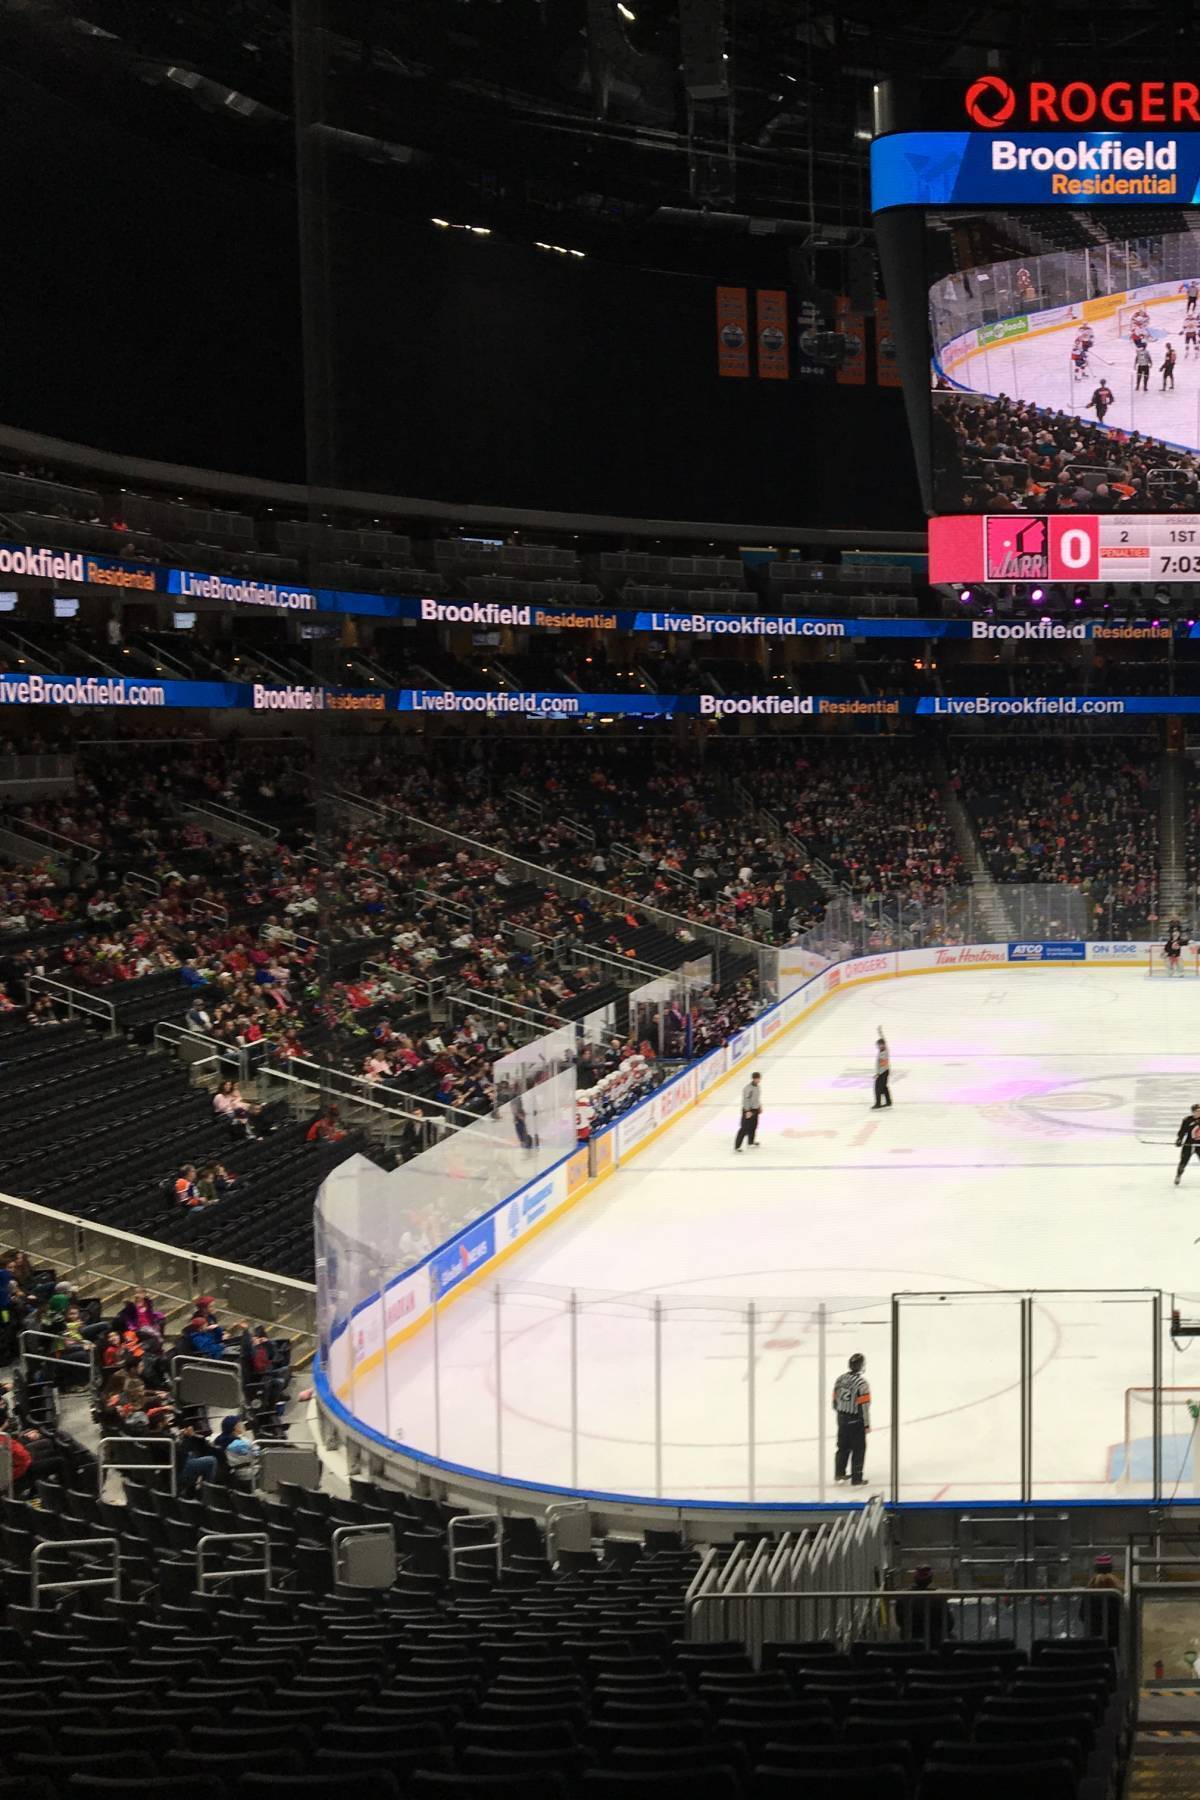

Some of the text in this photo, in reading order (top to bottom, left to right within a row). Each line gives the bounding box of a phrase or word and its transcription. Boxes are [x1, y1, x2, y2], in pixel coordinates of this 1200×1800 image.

[992, 140, 1177, 171] Brookfield
[1051, 174, 1177, 195] Residential
[1120, 531, 1129, 543] 2
[1170, 530, 1196, 543] 1ST
[1060, 529, 1091, 568] 0
[1101, 549, 1149, 557] PENALTIES
[87, 561, 156, 592] Residential
[179, 570, 318, 610] LiveBrookfield.com
[421, 599, 617, 629] Brookfield Residential
[651, 613, 845, 636] LiveBrookfield.com
[253, 684, 324, 709] Brookfield
[412, 690, 579, 712] LiveBrookfield.com
[700, 695, 900, 715] Brookfield Residential
[935, 697, 1125, 714] LiveBrookfield.com
[935, 947, 1005, 965] Tim Hortons
[1013, 944, 1044, 954] ATCO
[1092, 944, 1109, 954] ON
